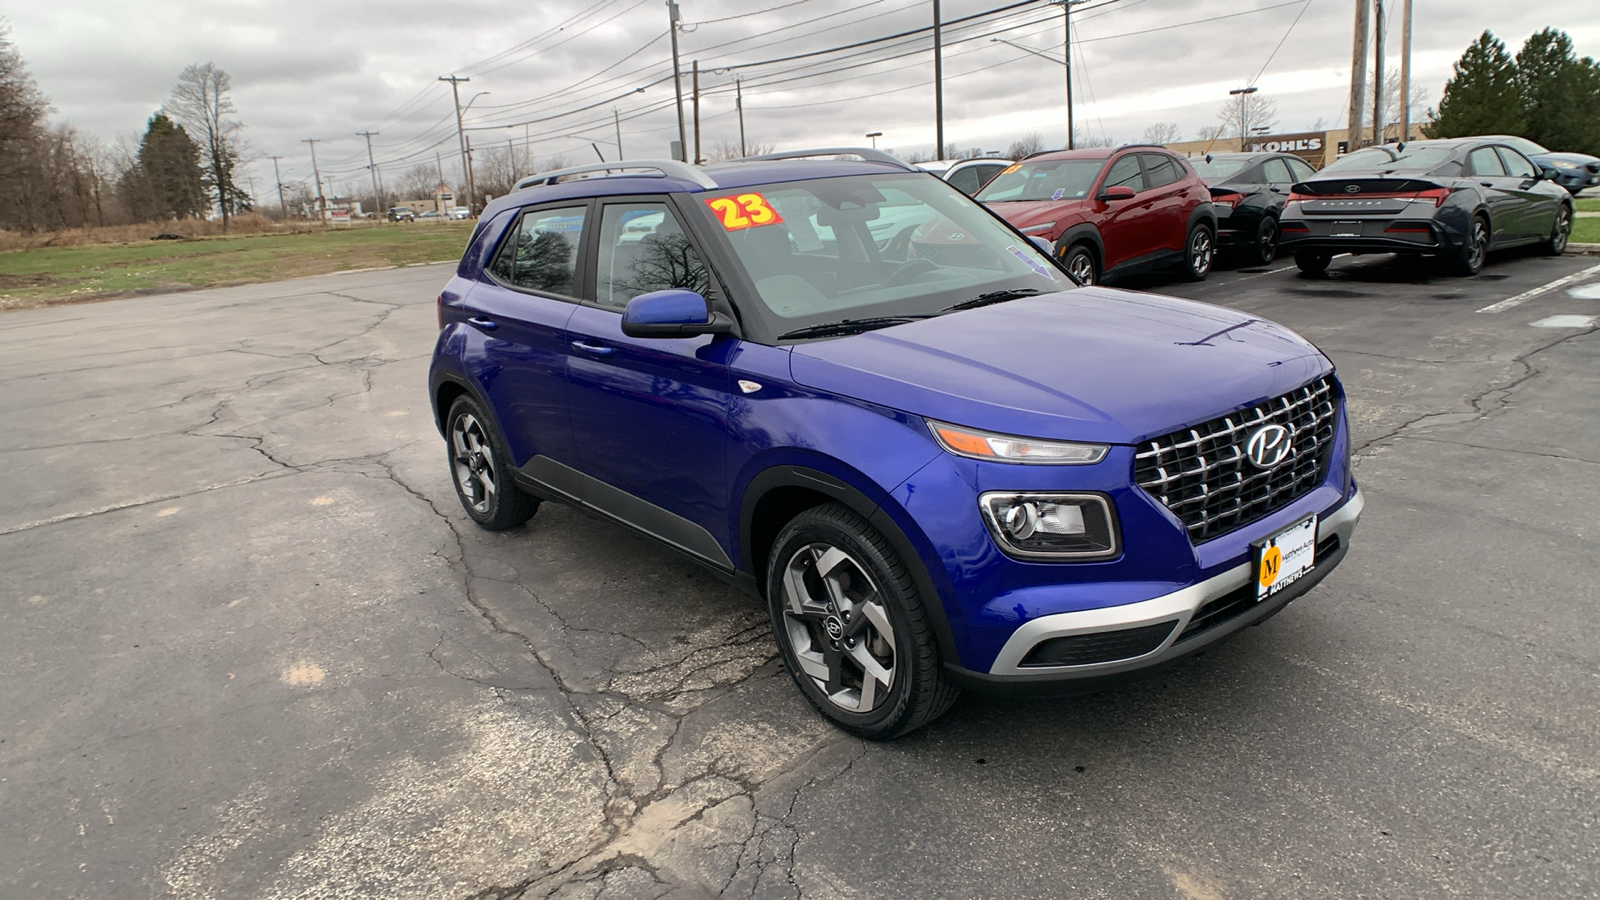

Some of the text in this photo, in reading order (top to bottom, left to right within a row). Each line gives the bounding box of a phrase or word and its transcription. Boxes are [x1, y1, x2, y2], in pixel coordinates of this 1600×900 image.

[1252, 138, 1322, 153] KOHL'S
[710, 193, 776, 229] 23
[1263, 554, 1278, 580] M
[1270, 569, 1303, 595] MATTHEWS
